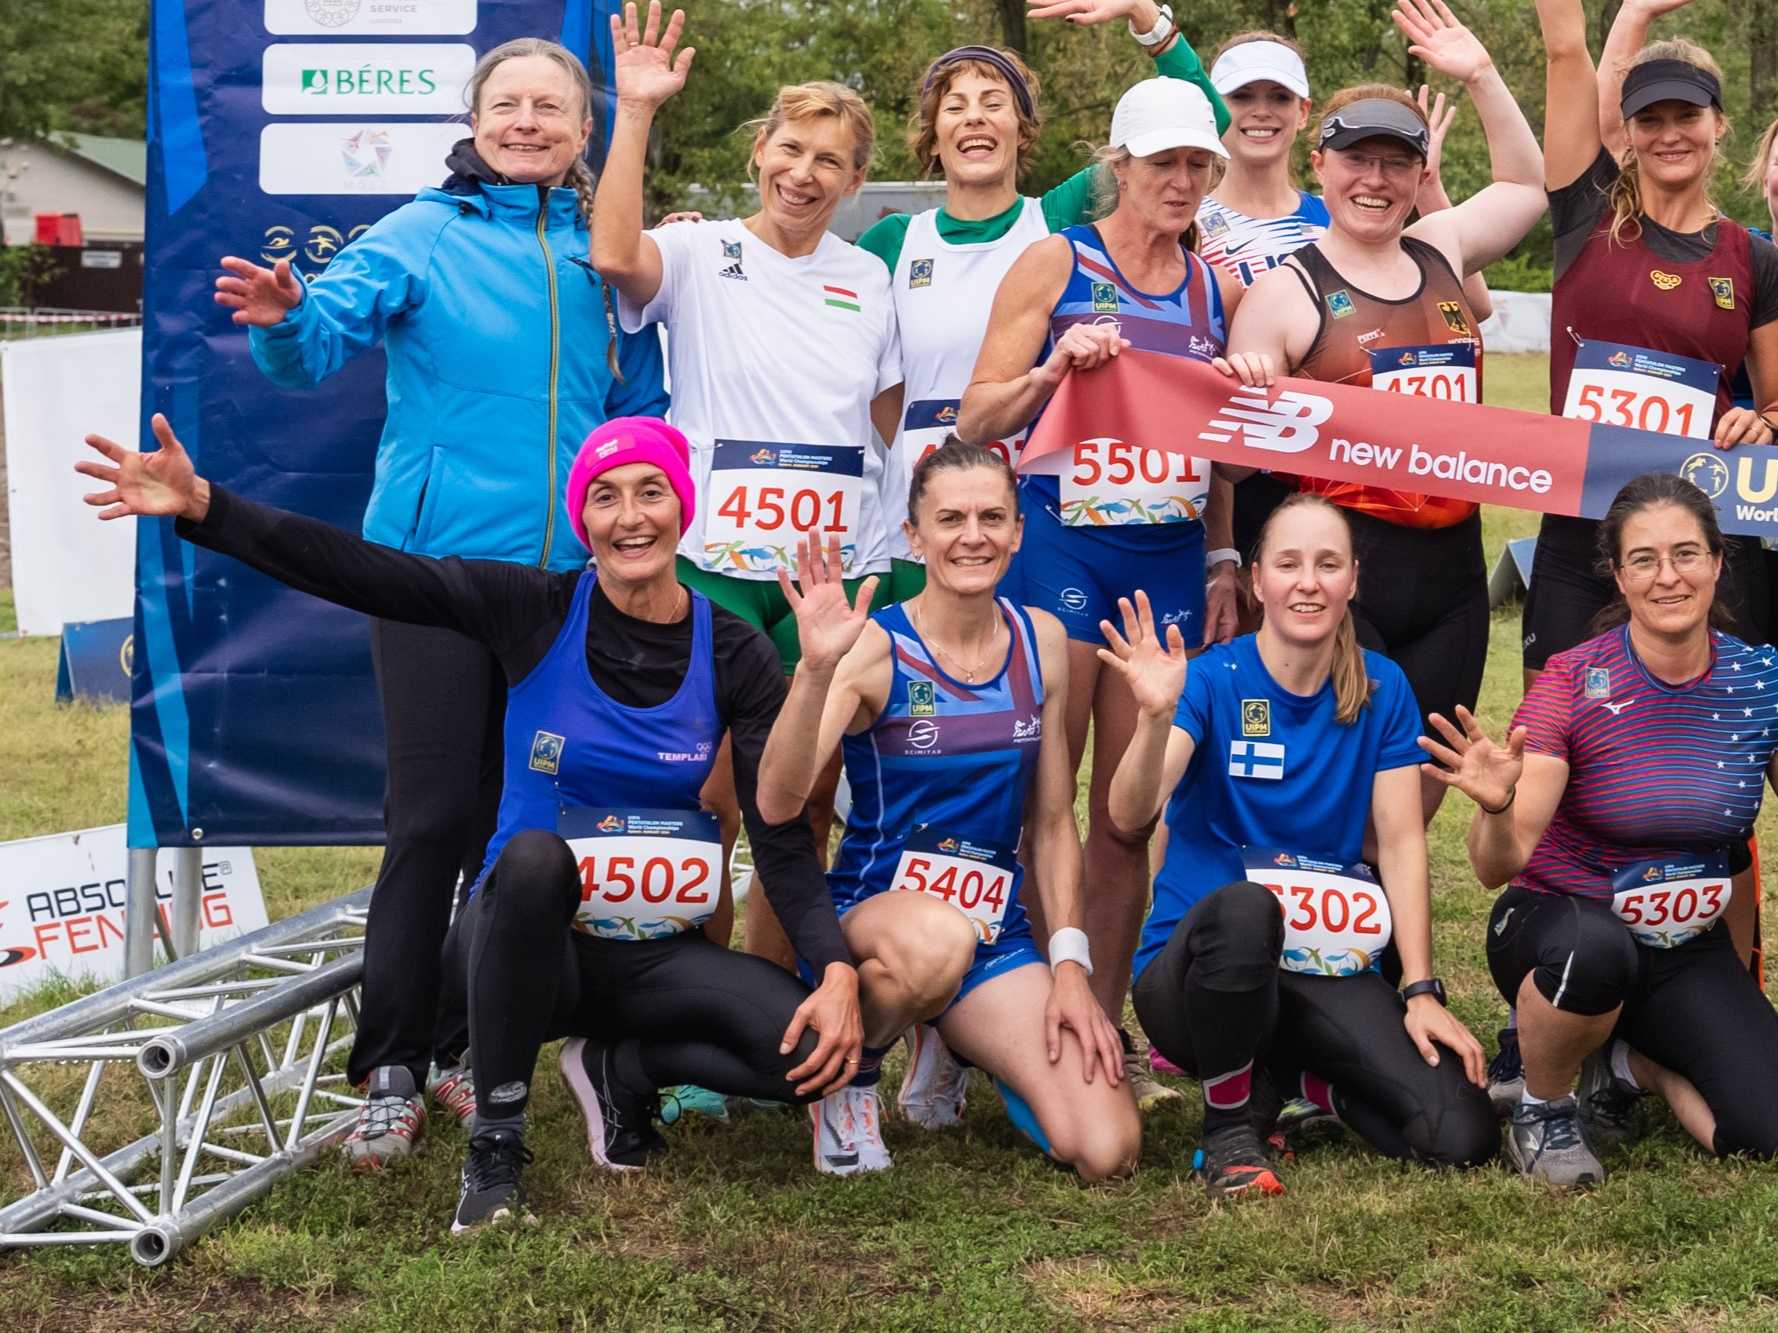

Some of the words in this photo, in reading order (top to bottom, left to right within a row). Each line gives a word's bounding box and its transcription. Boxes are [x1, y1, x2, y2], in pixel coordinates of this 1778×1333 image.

[370, 5, 418, 14] SERVICE
[336, 64, 436, 95] BÉRES
[719, 271, 748, 281] adidas
[1095, 302, 1117, 310] UIPM
[1578, 384, 1694, 437] 5301
[1073, 443, 1200, 486] 5501
[1329, 436, 1403, 470] new
[1408, 444, 1553, 494] balance
[718, 486, 848, 532] 4501
[912, 704, 933, 713] UIPM
[1245, 723, 1268, 732] UIPM
[533, 757, 556, 770] UIPM
[578, 856, 710, 904] 4502
[900, 858, 1005, 914] 5404
[1620, 884, 1724, 927] 5303
